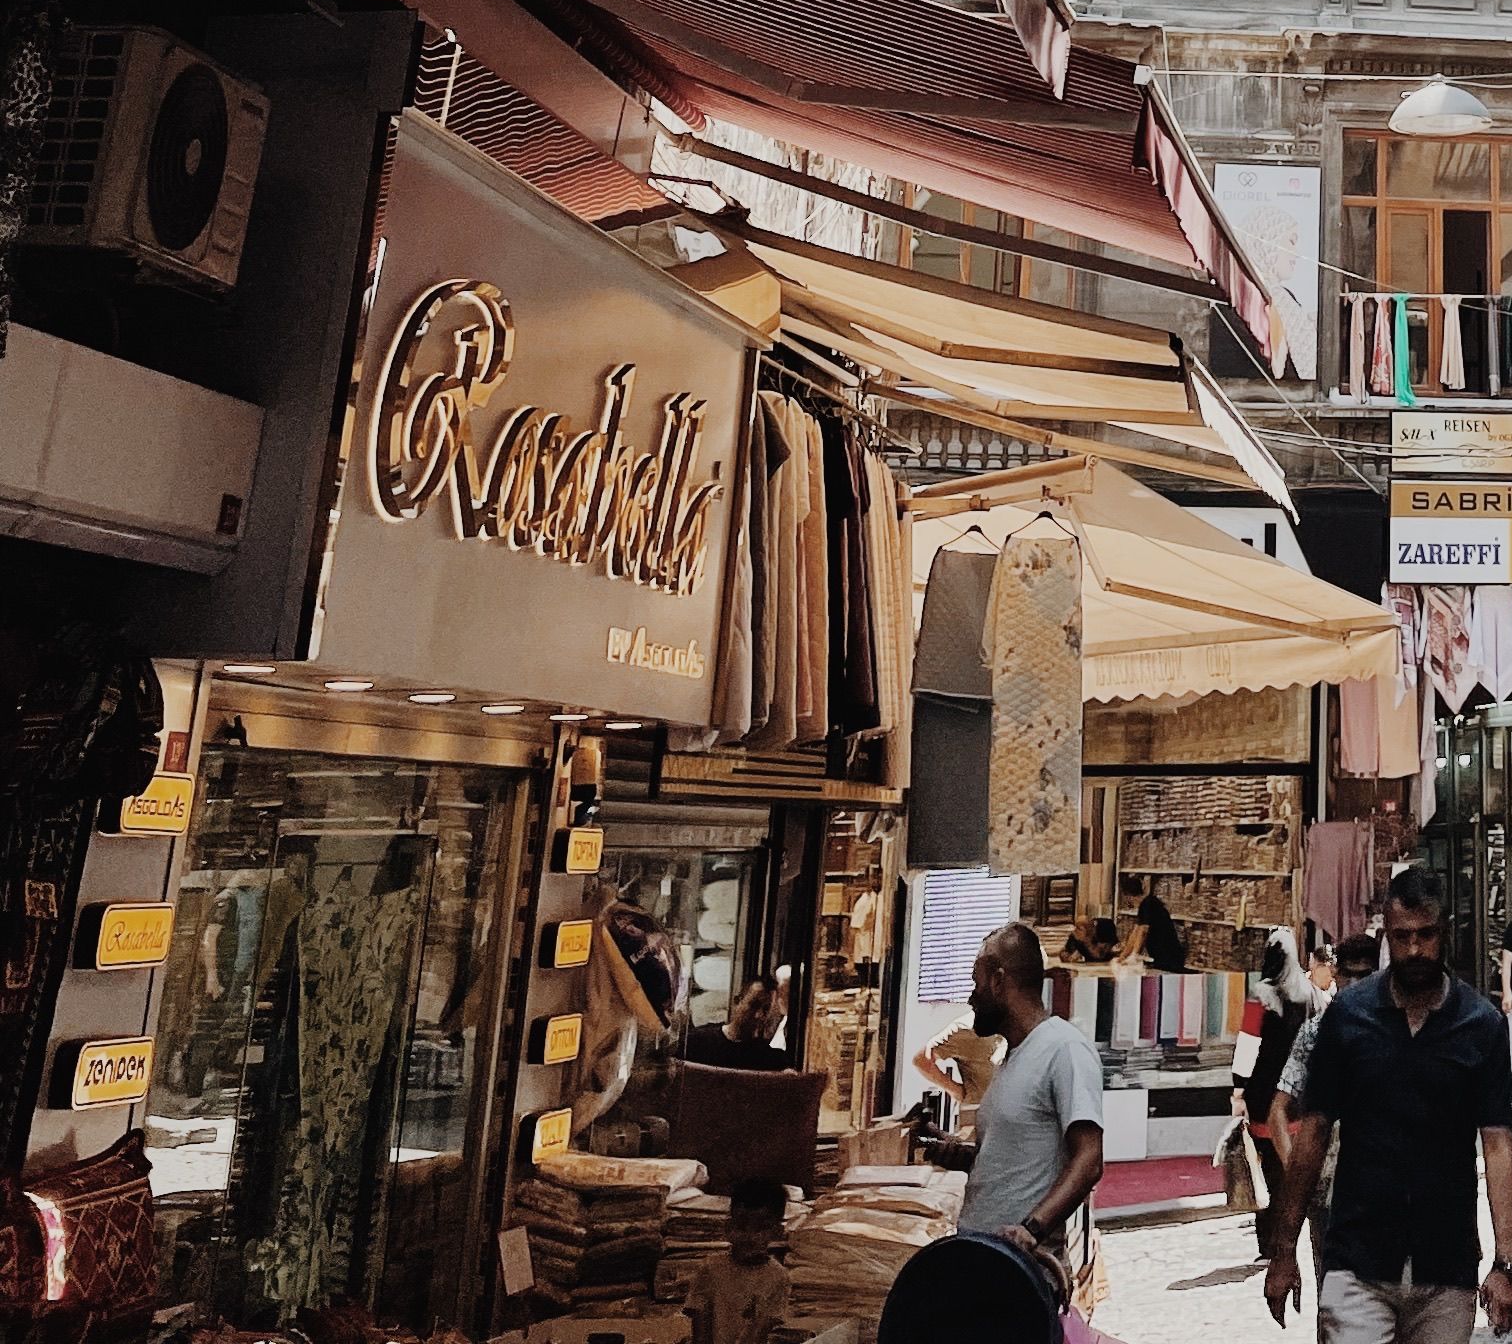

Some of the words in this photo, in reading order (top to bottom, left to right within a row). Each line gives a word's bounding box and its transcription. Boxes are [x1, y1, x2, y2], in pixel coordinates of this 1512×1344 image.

[1411, 487, 1512, 511] SABRİ
[1398, 537, 1502, 566] ZAREFFİ
[105, 920, 168, 953] Rosabella
